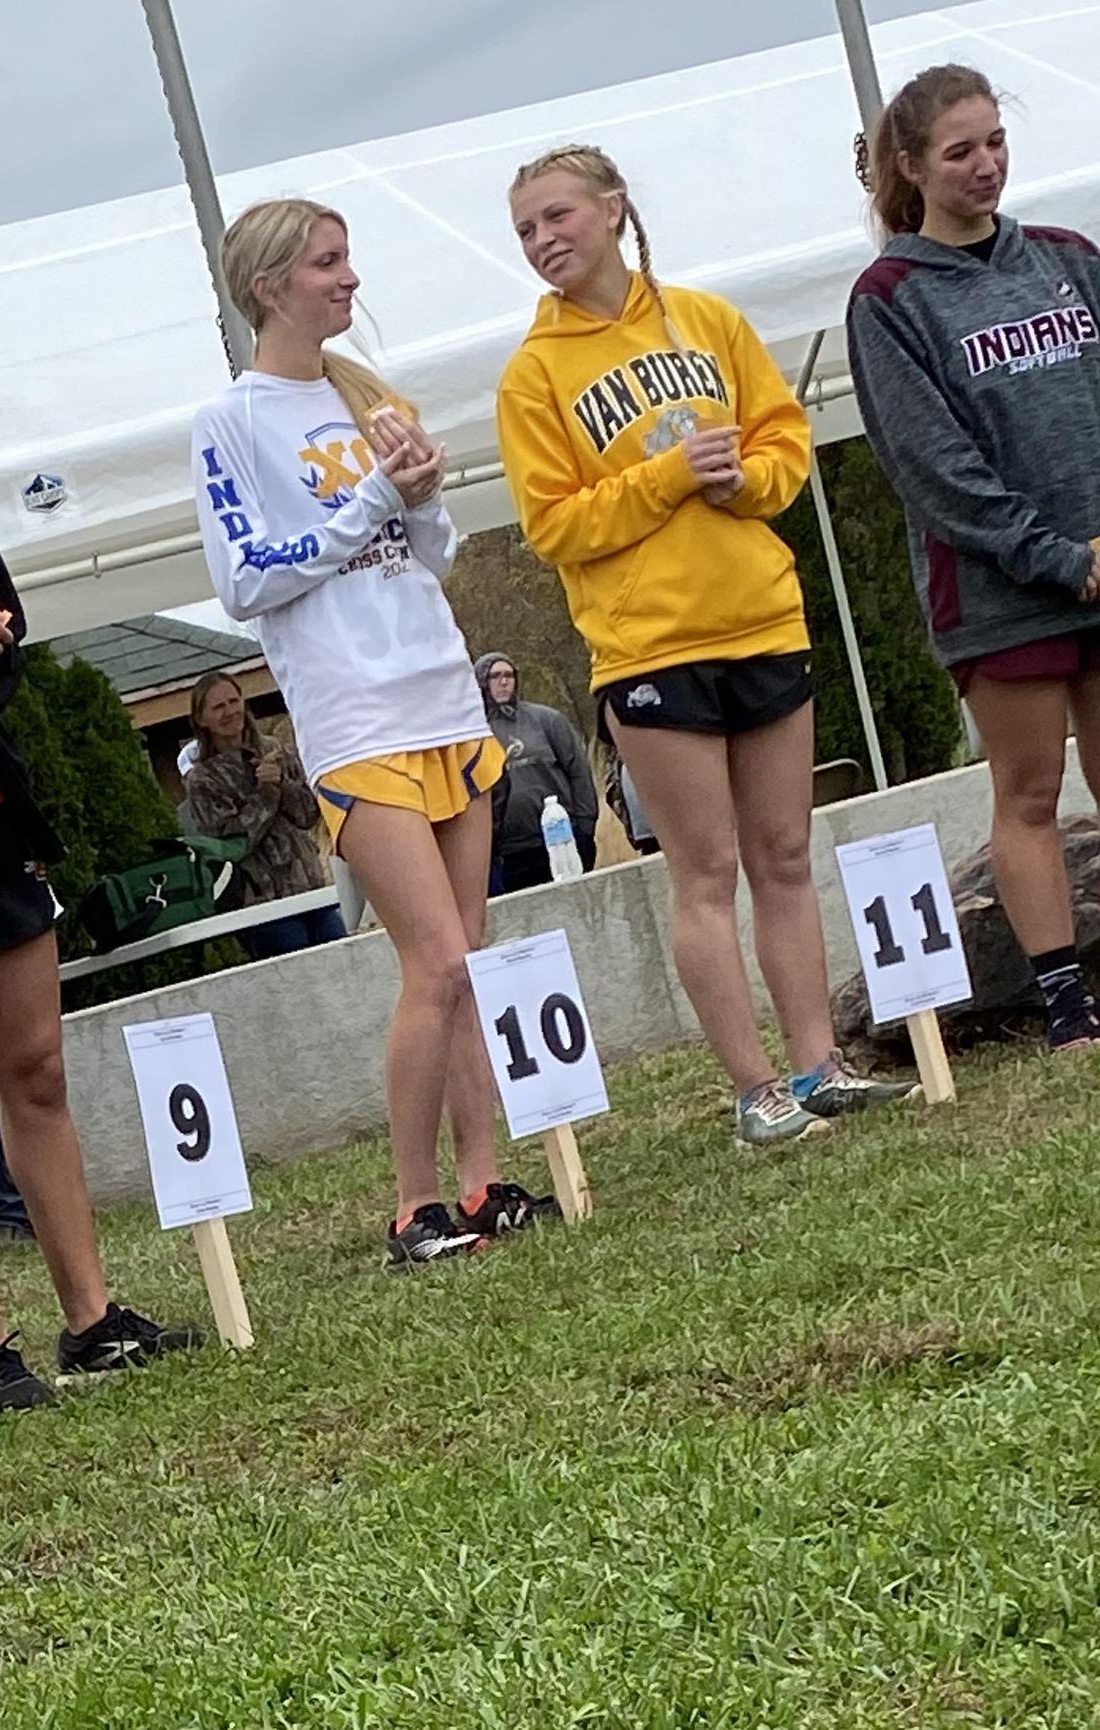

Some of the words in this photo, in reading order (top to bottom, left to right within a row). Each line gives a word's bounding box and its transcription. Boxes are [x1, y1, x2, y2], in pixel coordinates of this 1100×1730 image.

[960, 306, 1099, 377] INDIANS
[1008, 344, 1083, 375] SOFTBALL
[573, 366, 645, 456] VAN
[627, 350, 730, 409] BUREN
[863, 882, 953, 969] 11
[494, 992, 587, 1083] 10
[169, 1083, 211, 1162] 9
